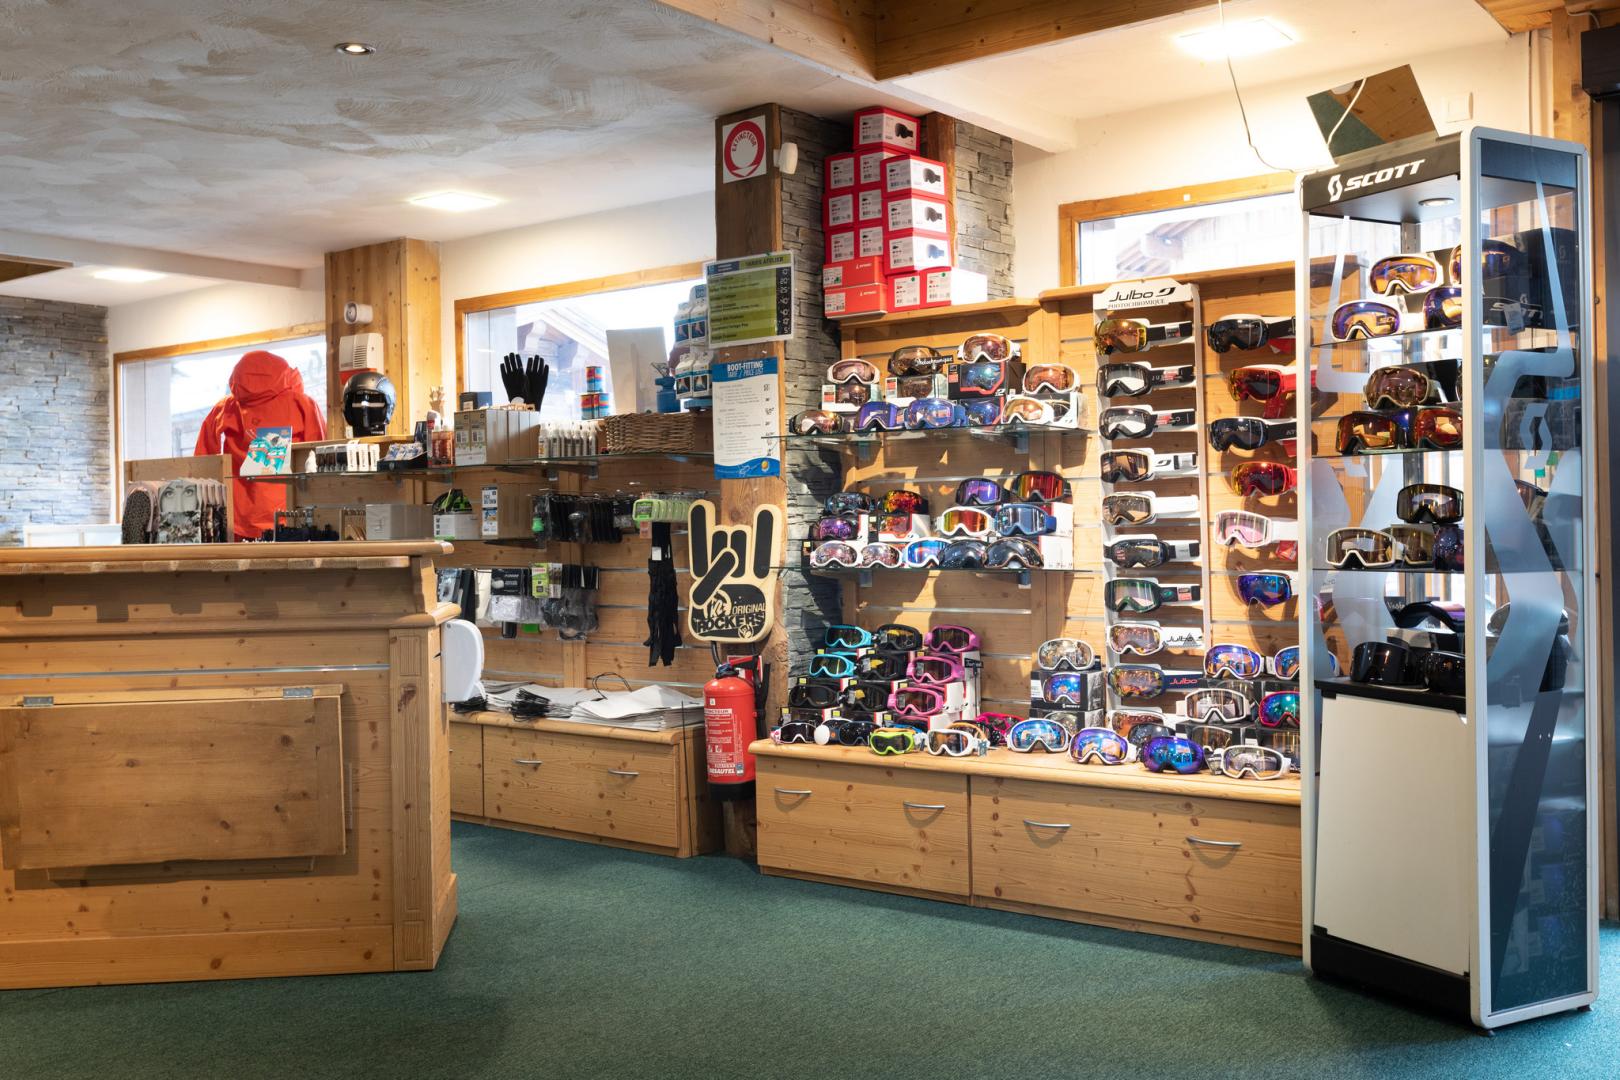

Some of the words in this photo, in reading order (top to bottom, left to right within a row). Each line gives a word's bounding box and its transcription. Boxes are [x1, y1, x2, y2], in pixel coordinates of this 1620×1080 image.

[731, 131, 757, 152] EXTINCTEUR
[1344, 159, 1426, 192] SCOTT
[1109, 289, 1154, 302] Julbo
[727, 360, 764, 371] BOOT-FITTING
[732, 602, 766, 615] ORIGINAL
[697, 612, 766, 633] ROCKERS
[1169, 677, 1198, 685] Julbo
